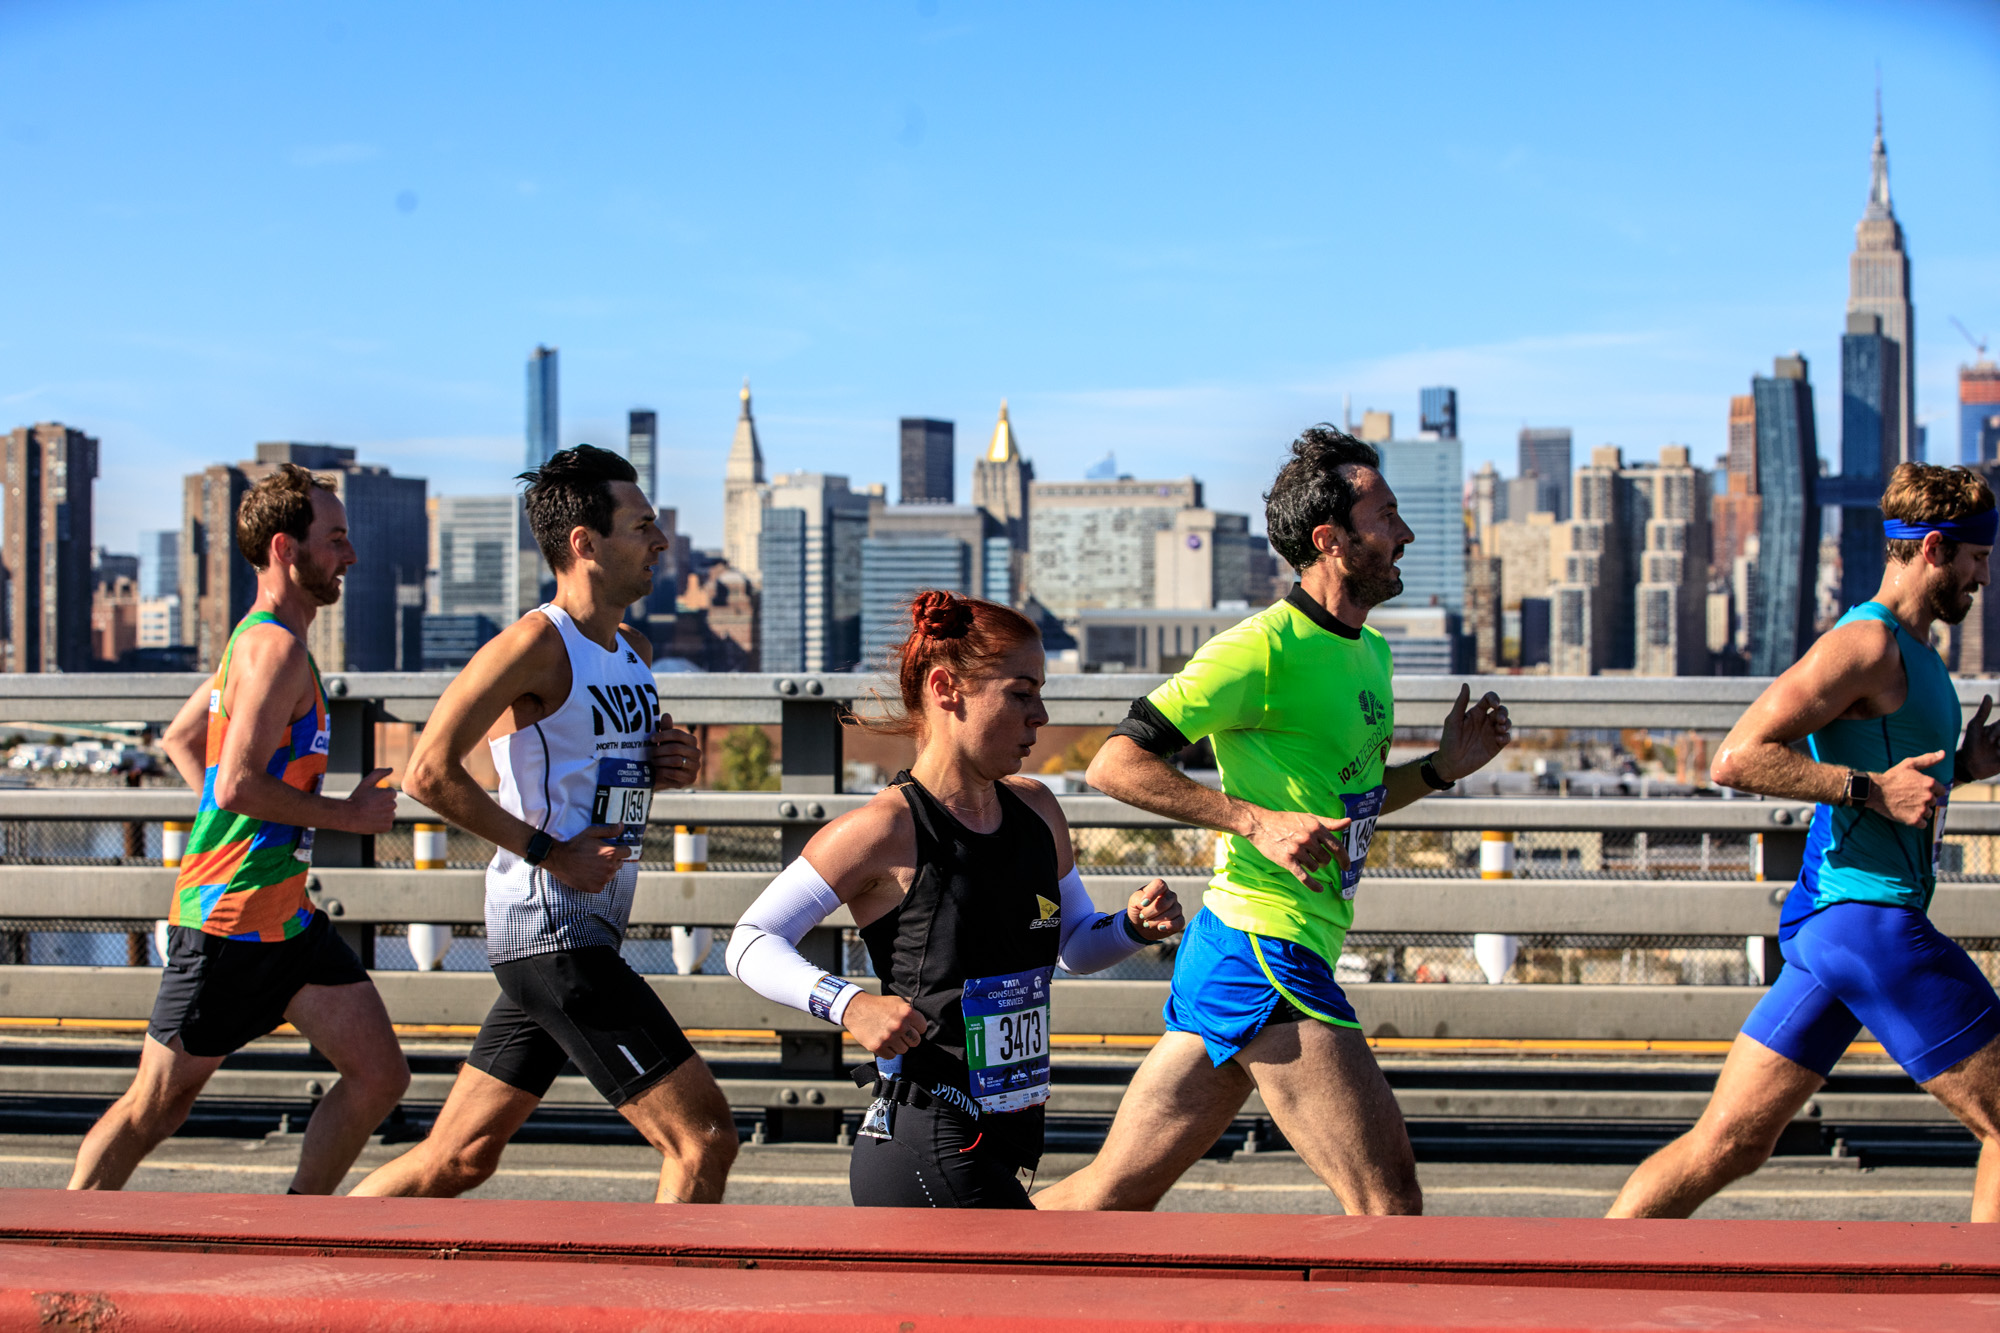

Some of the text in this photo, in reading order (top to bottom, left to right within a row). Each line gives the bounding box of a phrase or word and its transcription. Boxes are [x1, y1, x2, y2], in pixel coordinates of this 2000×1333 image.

[596, 741, 619, 751] NORTH
[620, 789, 645, 822] 1159
[1002, 979, 1020, 988] TATA
[988, 986, 1029, 999] CONSULTANCY
[997, 996, 1024, 1008] SERVICES
[999, 1010, 1042, 1061] 3473
[974, 1033, 980, 1057] 1
